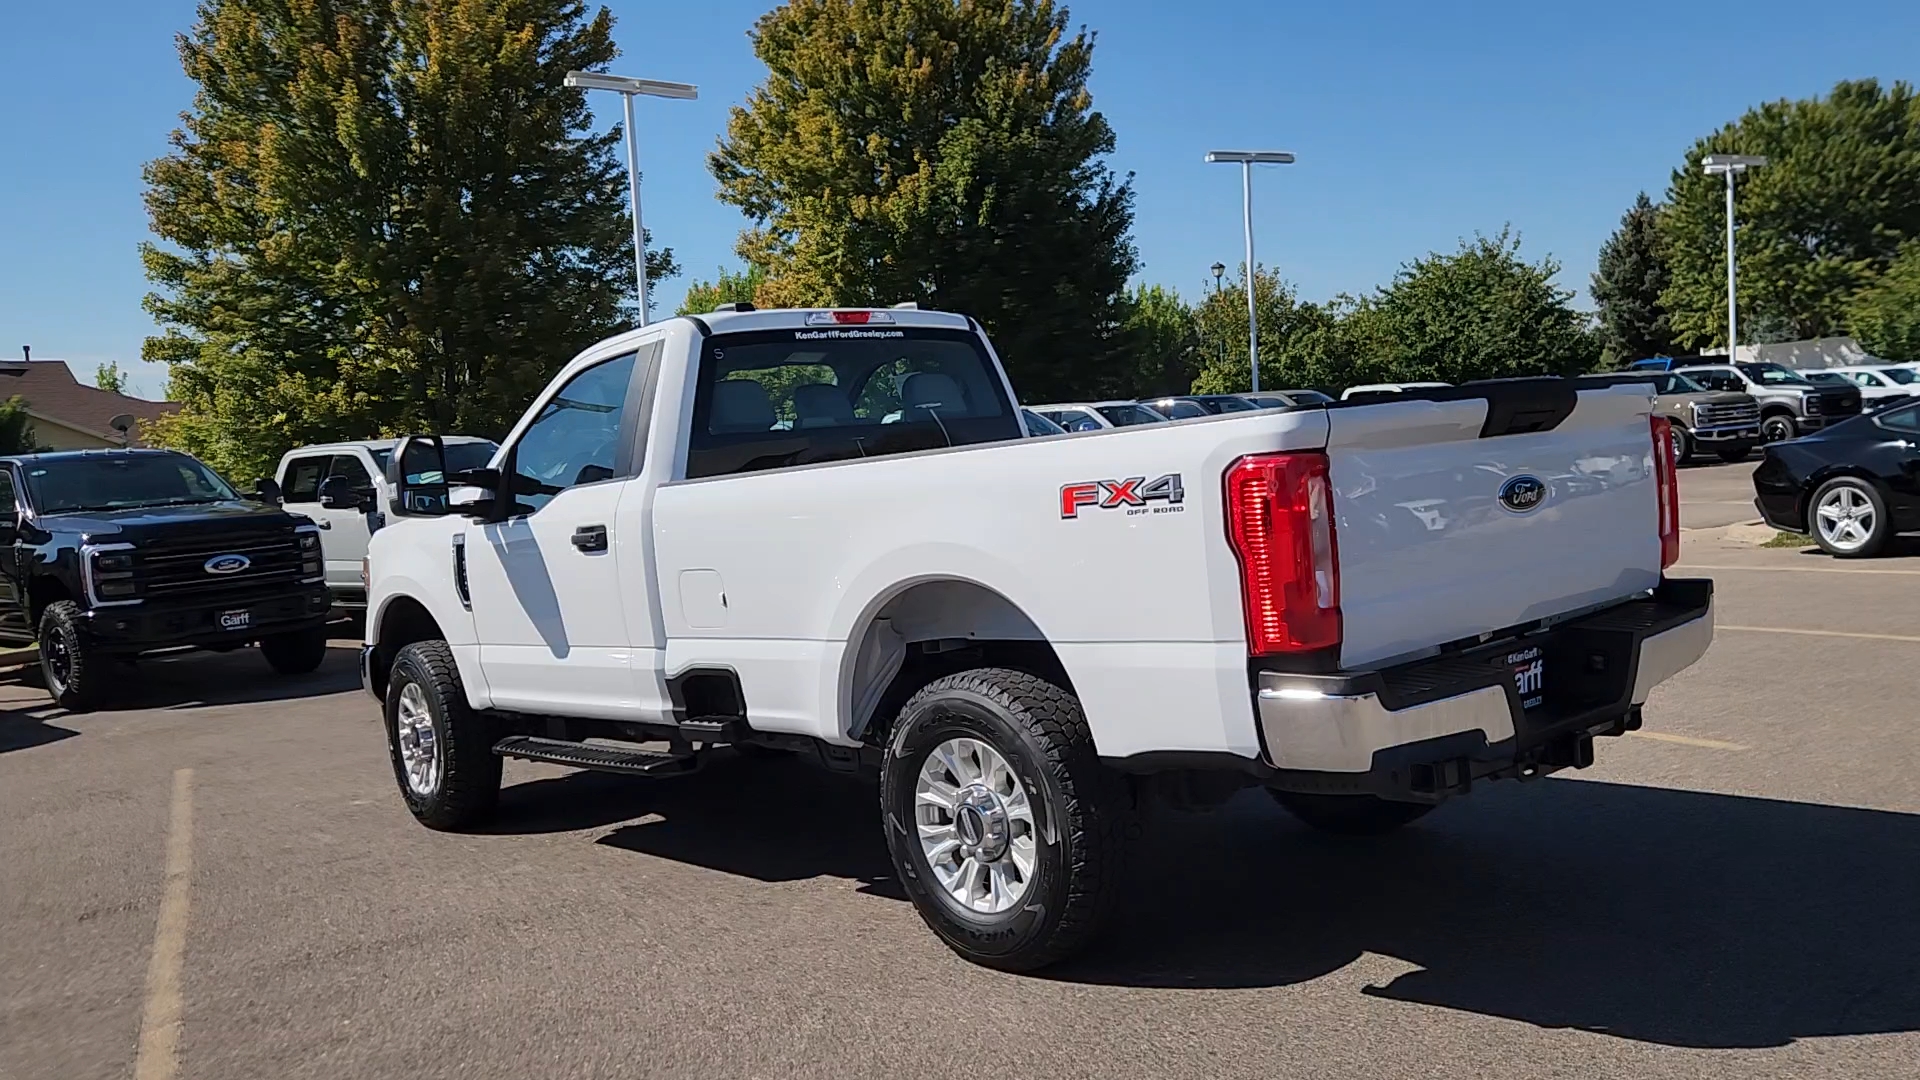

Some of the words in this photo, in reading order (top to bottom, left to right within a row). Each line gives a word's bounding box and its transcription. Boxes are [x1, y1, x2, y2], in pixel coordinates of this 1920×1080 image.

[794, 329, 905, 340] KenGarffFordGreeley.com
[1059, 473, 1185, 519] FX4
[1513, 483, 1538, 504] Ford
[1126, 508, 1150, 516] OFF
[1153, 506, 1185, 514] ROAD
[220, 612, 251, 627] Garff
[1514, 659, 1543, 694] arff
